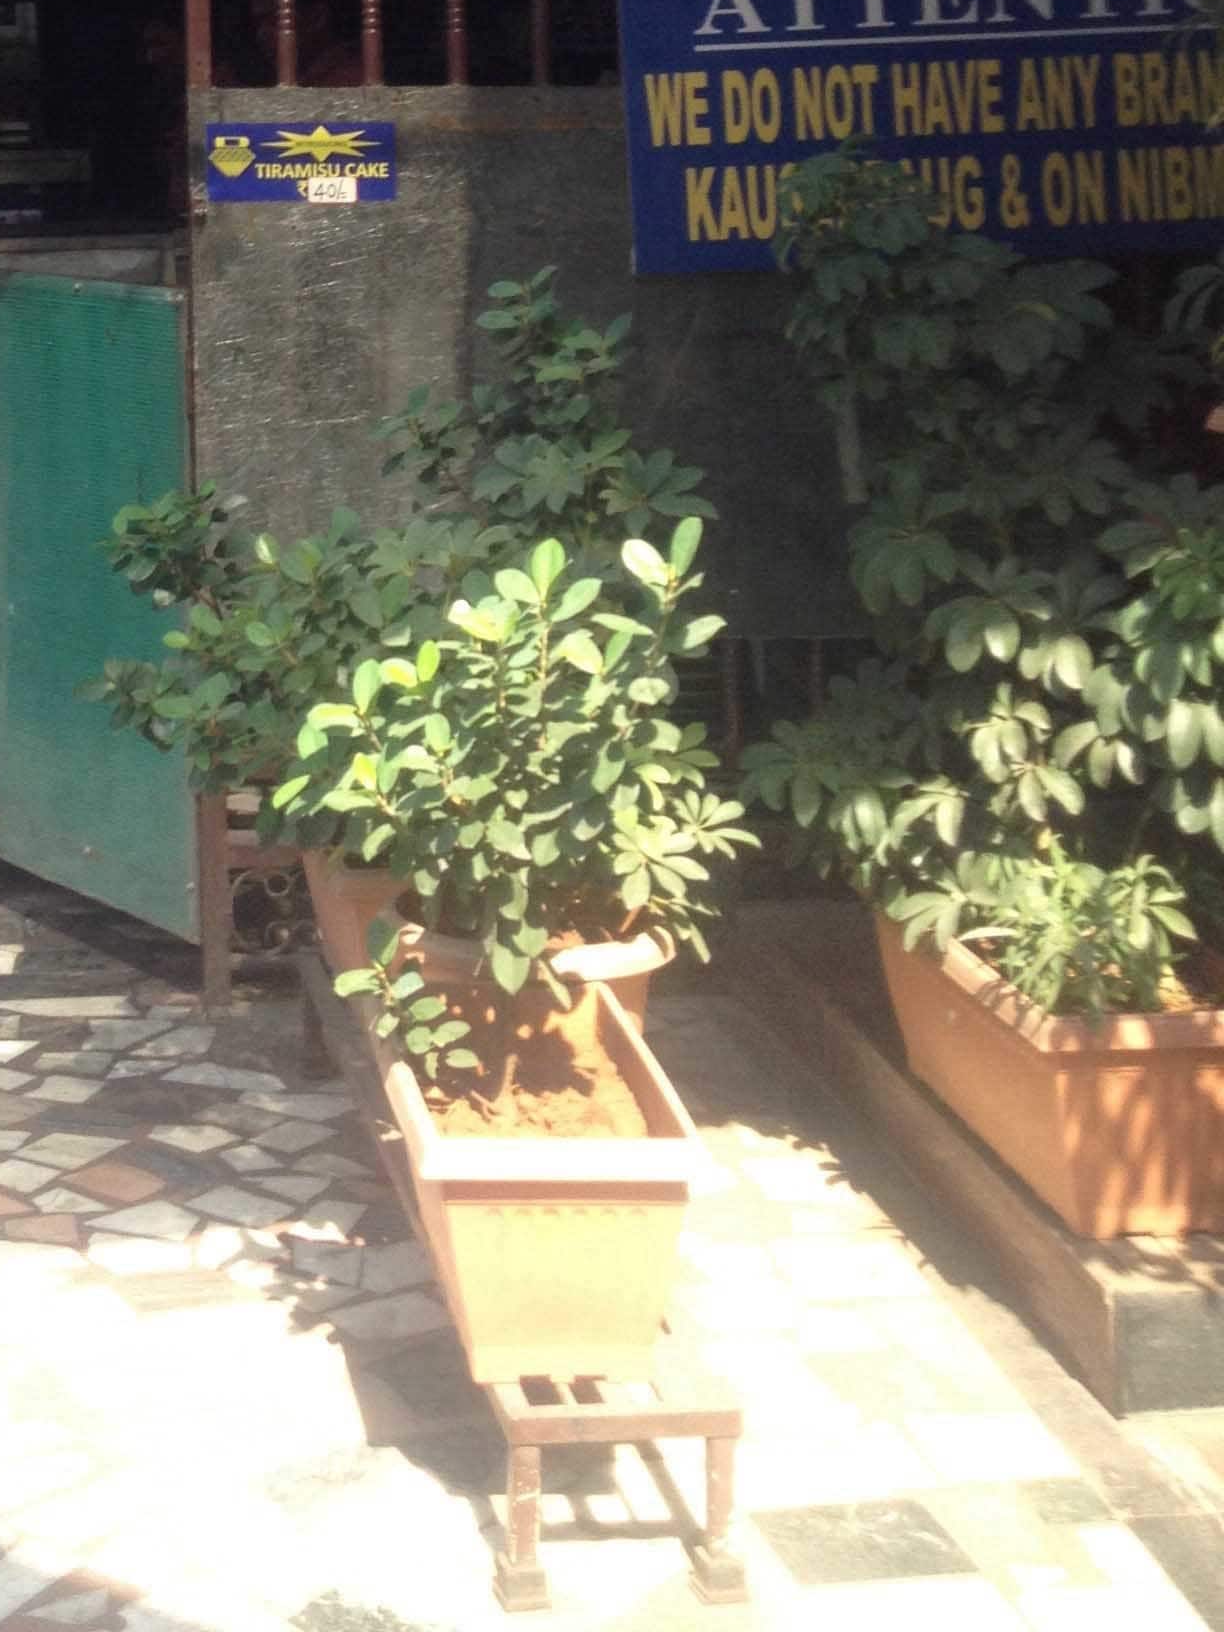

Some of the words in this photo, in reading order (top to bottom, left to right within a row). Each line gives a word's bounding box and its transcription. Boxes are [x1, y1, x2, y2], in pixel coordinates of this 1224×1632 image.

[644, 72, 712, 148] WE
[722, 68, 782, 143] DO
[793, 65, 879, 141] NOT
[891, 59, 1005, 136] HAVE
[1016, 55, 1101, 132] ANY
[254, 163, 339, 179] TIRAMISU
[344, 162, 389, 179] CAKE
[685, 161, 852, 241] KAU
[999, 153, 1030, 229] &
[1041, 149, 1107, 227] ON
